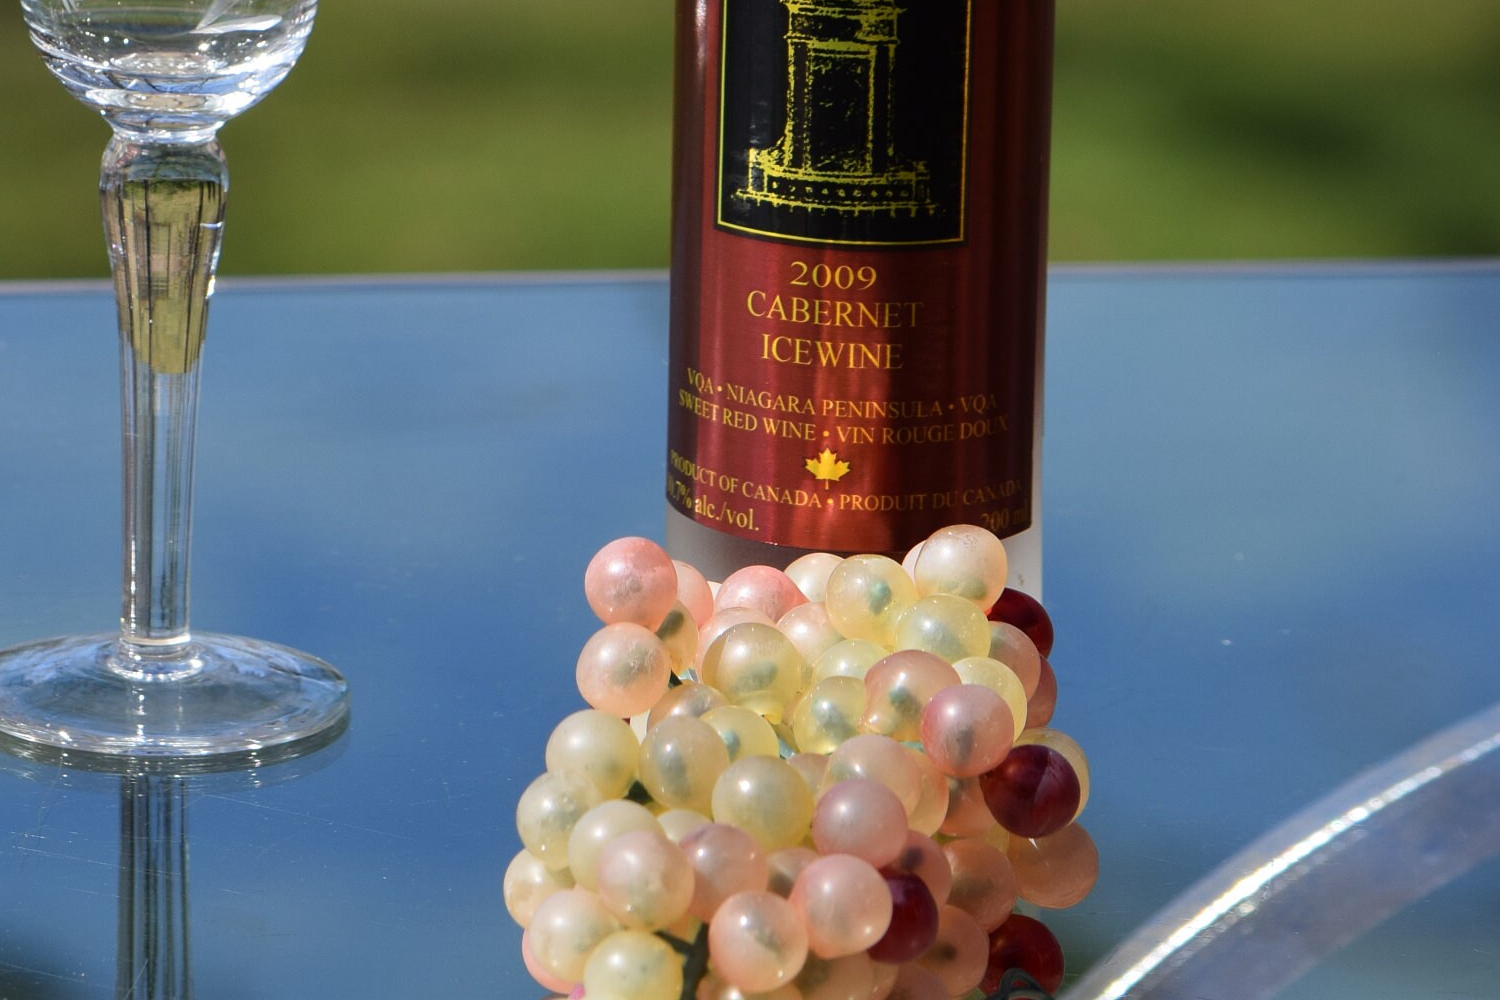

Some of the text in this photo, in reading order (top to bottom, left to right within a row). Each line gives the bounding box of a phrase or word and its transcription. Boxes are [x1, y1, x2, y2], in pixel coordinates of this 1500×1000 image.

[790, 261, 877, 290] 2009
[746, 290, 924, 328] CABERNET
[761, 333, 904, 369] ICEWINE
[687, 367, 997, 419] VQA NIAGARA PENINSULA VQA
[678, 388, 1009, 445] SWEET RED WINE VIN ROUGE DOUX
[670, 449, 717, 488] PRODUCT
[718, 474, 739, 493] OF
[742, 481, 822, 508] CANADA
[839, 494, 927, 511] PRODUIT
[932, 491, 958, 510] DU
[695, 494, 760, 531] alc./vol.
